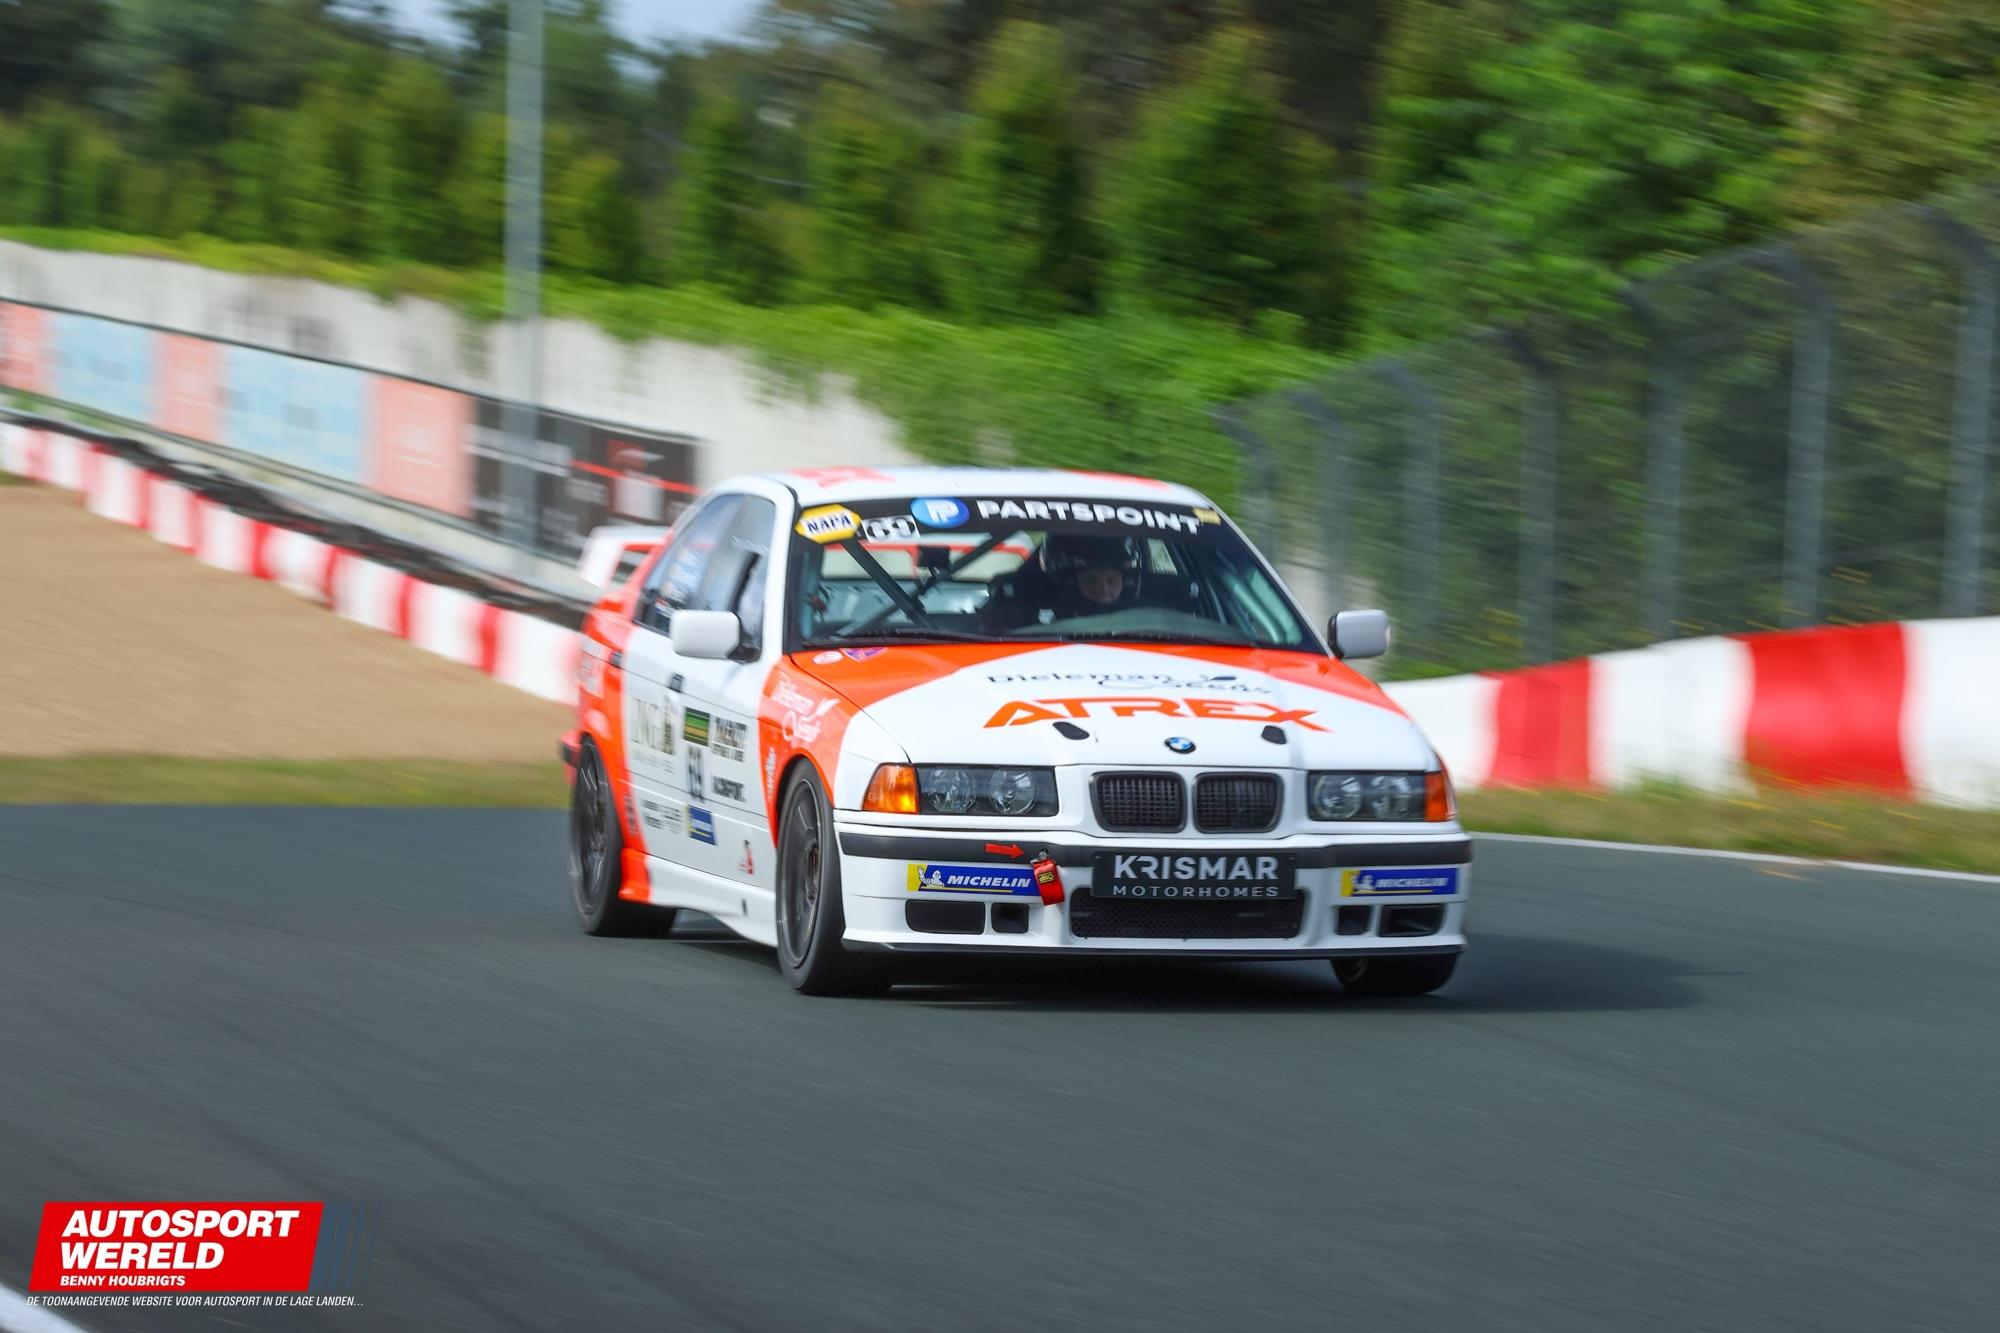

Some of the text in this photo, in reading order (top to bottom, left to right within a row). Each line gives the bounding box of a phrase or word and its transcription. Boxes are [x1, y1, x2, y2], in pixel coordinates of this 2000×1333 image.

[807, 513, 852, 533] NAPA
[976, 499, 1200, 535] PARTSPOINT
[983, 697, 1331, 732] ATREX
[1114, 855, 1279, 880] KRISMAR
[947, 874, 1031, 888] MICHELIN
[1113, 886, 1279, 898] MOTORHOMES
